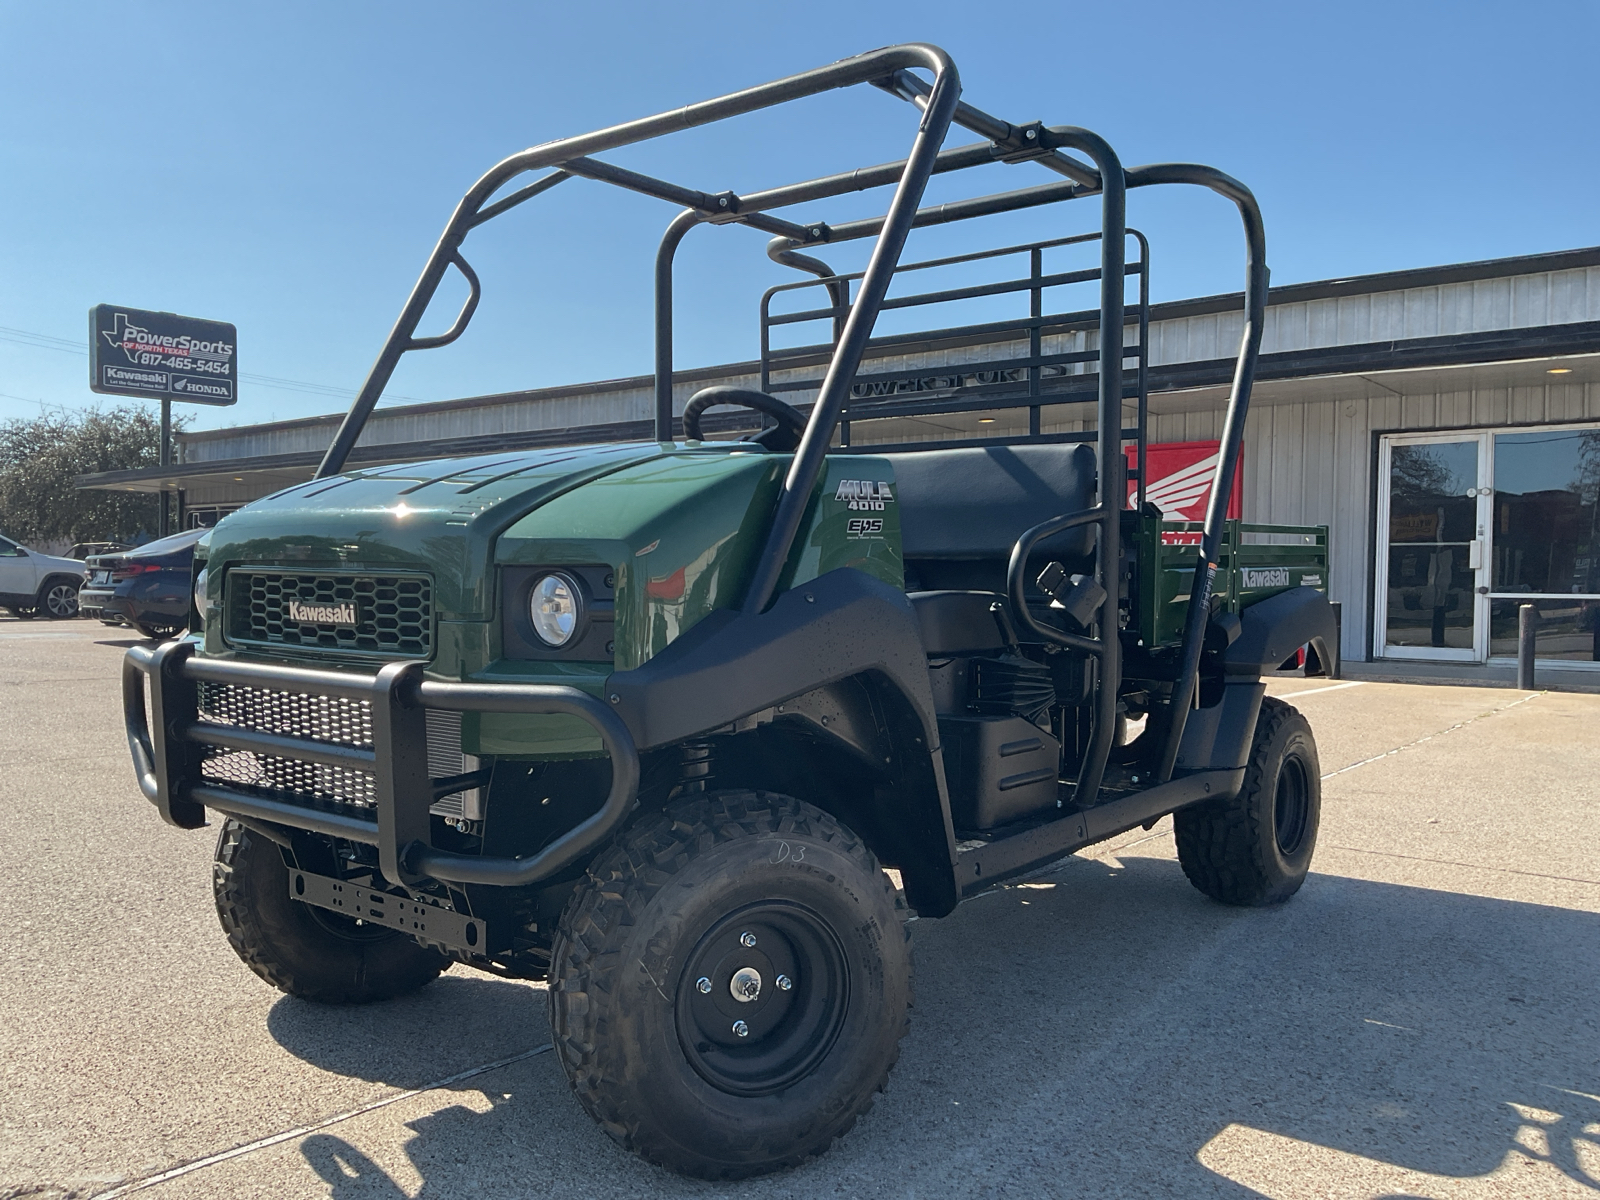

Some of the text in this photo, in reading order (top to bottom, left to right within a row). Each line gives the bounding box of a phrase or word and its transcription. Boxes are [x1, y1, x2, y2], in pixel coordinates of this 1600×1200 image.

[123, 328, 233, 355] PowerSports
[123, 341, 189, 356] OF NORTH TEXAS
[141, 353, 230, 375] 817-465-5454
[107, 368, 167, 384] Kawasaki
[186, 382, 229, 395] HONDA
[835, 480, 895, 502] MULE
[848, 501, 885, 511] 4010
[1241, 567, 1290, 588] Kawasaki
[289, 601, 355, 623] Kawasaki
